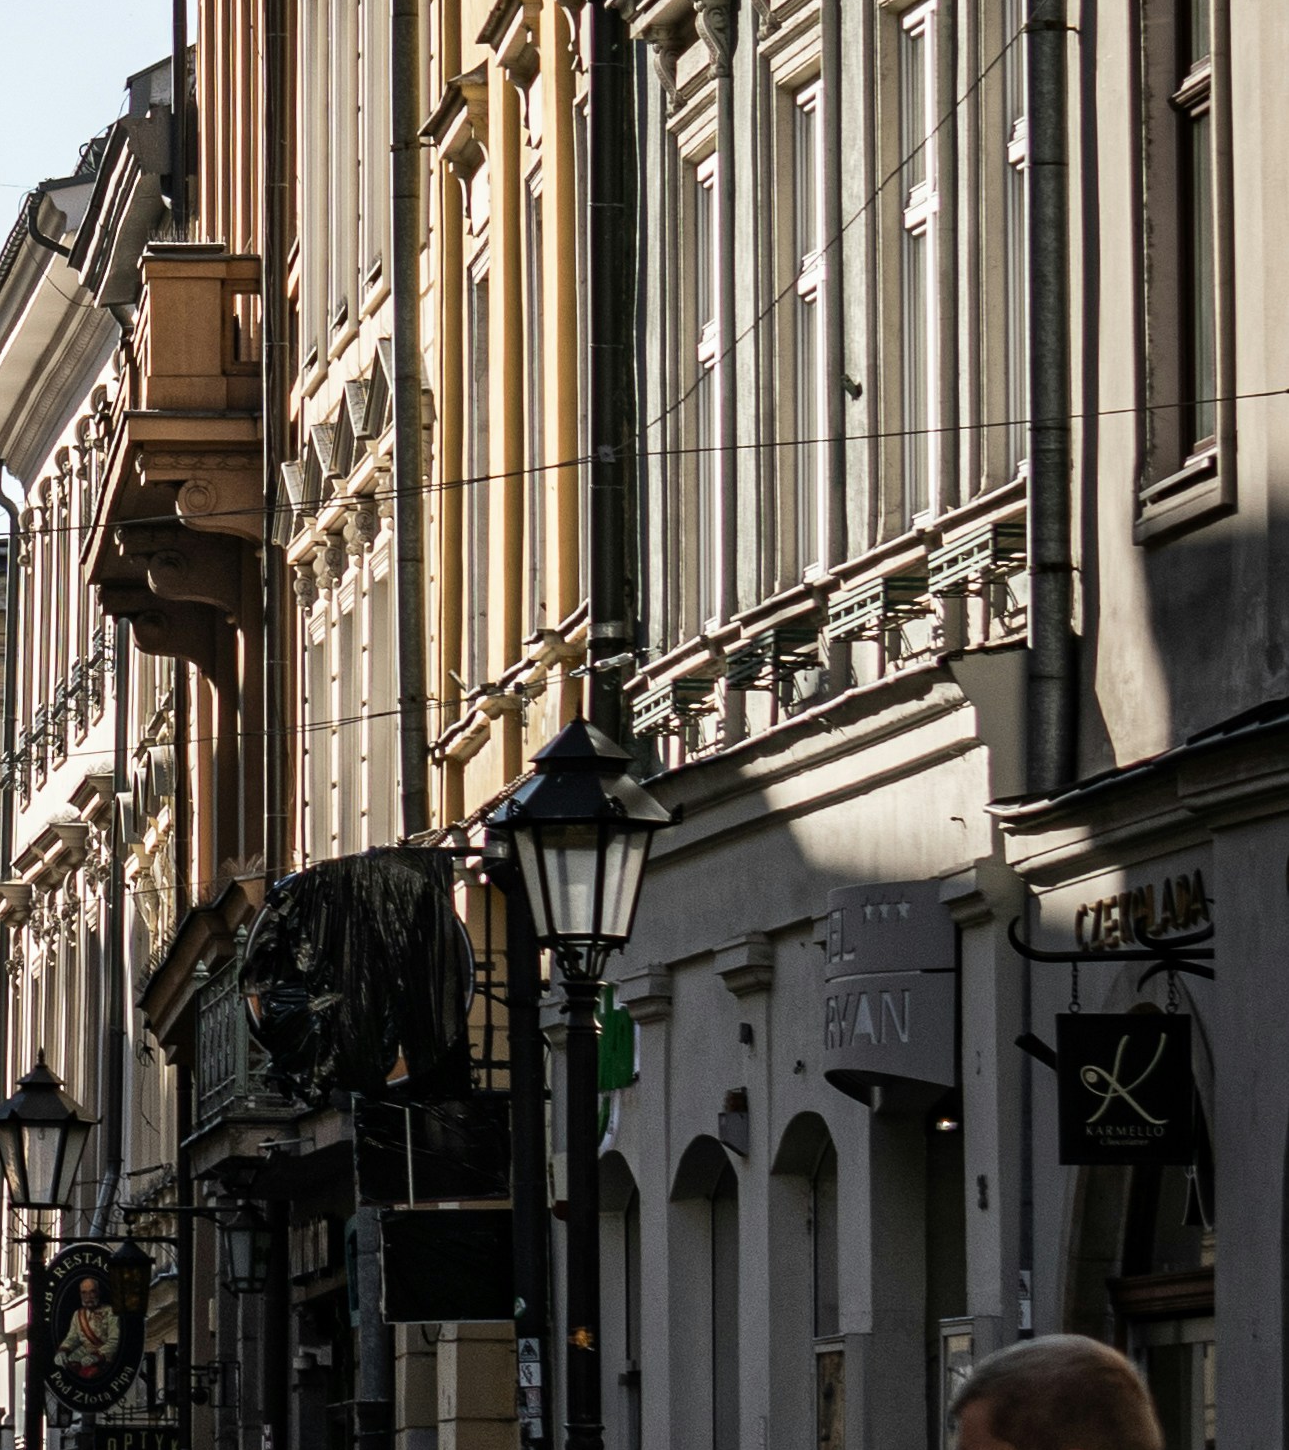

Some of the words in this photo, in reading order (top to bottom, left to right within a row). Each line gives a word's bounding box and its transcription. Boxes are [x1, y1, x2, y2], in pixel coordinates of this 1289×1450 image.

[827, 908, 855, 964] EL
[1075, 868, 1210, 953] CZEKOLADA
[825, 989, 911, 1050] RYAN
[1085, 1124, 1166, 1138] KARMELLO
